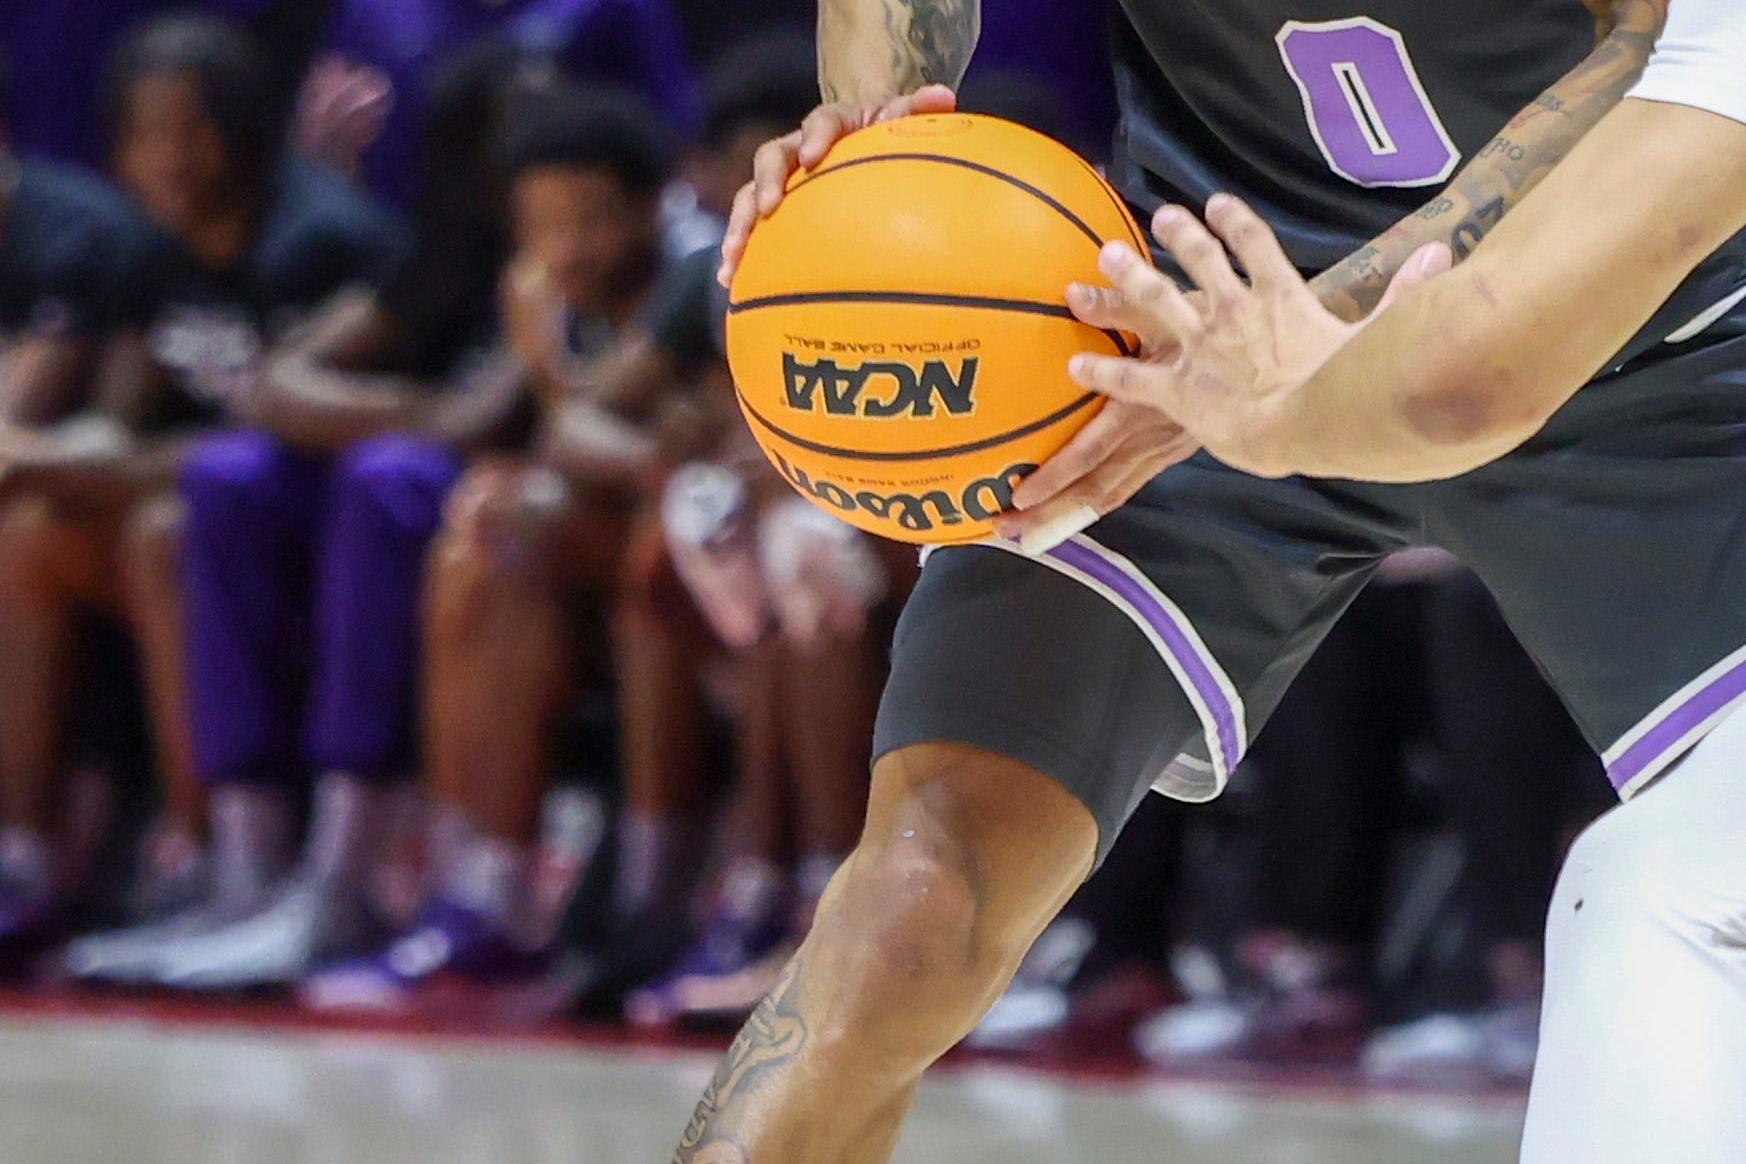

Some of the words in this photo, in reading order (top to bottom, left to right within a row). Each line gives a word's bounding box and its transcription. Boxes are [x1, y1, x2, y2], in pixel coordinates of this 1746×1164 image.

[1275, 15, 1462, 188] 0
[784, 333, 826, 353] BALL
[831, 339, 885, 355] GAME
[890, 338, 981, 354] OFFICIAL
[781, 350, 981, 420] NCAA
[771, 448, 1041, 532] Wilson
